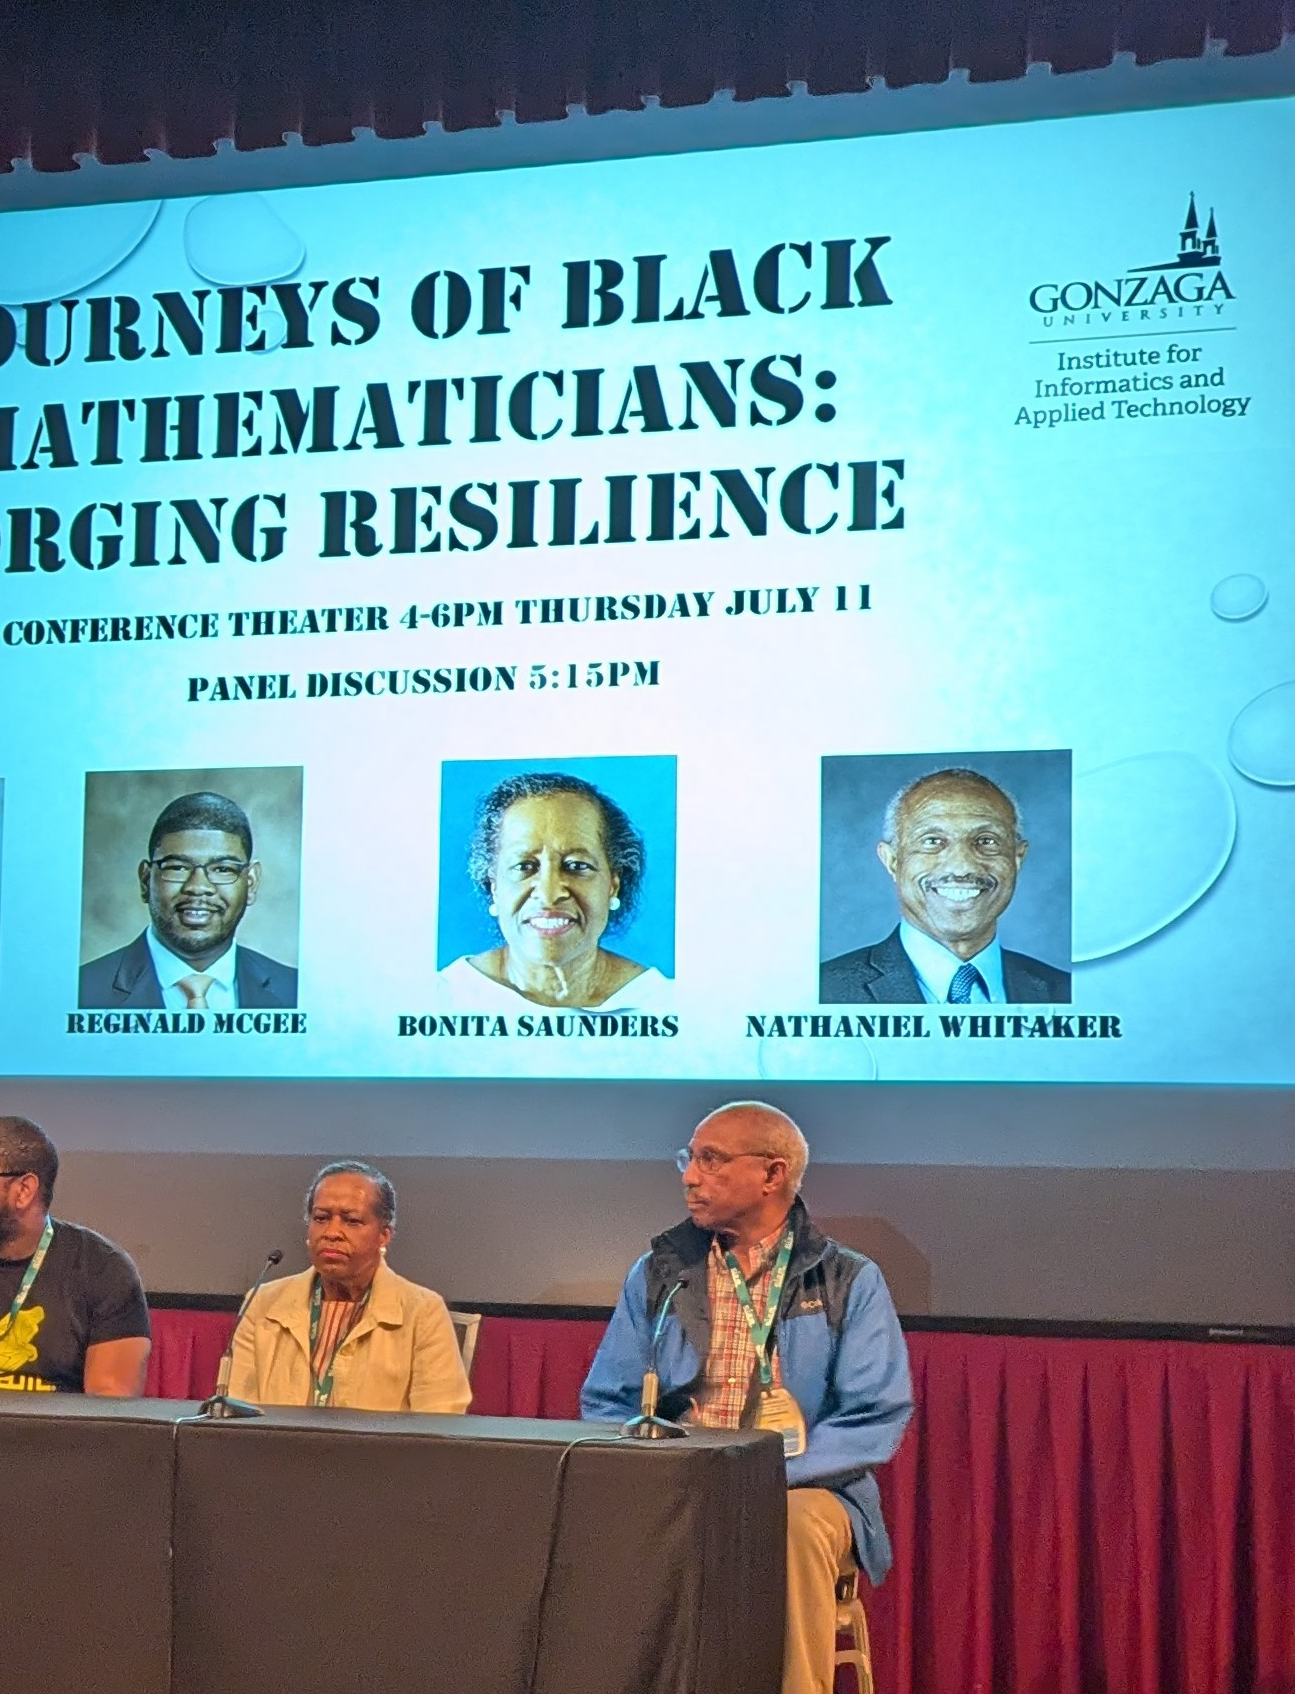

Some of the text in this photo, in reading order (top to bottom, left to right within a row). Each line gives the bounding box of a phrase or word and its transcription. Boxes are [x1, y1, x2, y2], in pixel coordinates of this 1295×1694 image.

[411, 265, 530, 339] OF
[562, 236, 893, 329] BLACK
[1029, 271, 1236, 313] GONZAGA
[1043, 304, 1225, 327] UNIVERSITY
[1057, 344, 1202, 371] Institute for
[1035, 367, 1225, 398] Informatics and
[1014, 395, 1251, 429] Applied Technology
[318, 459, 905, 557] RESILIENCE
[3, 585, 872, 645] CONFERENCE THEATER 4-6PM THURSDAY JULY 11
[188, 661, 660, 702] PANEL DISCUSSION 5:15PM
[66, 1013, 307, 1034] REGINALD MCGEE
[398, 1015, 679, 1037] BONITA SAUNDERS
[746, 1015, 1123, 1038] NATHANIEL WHITAKER
